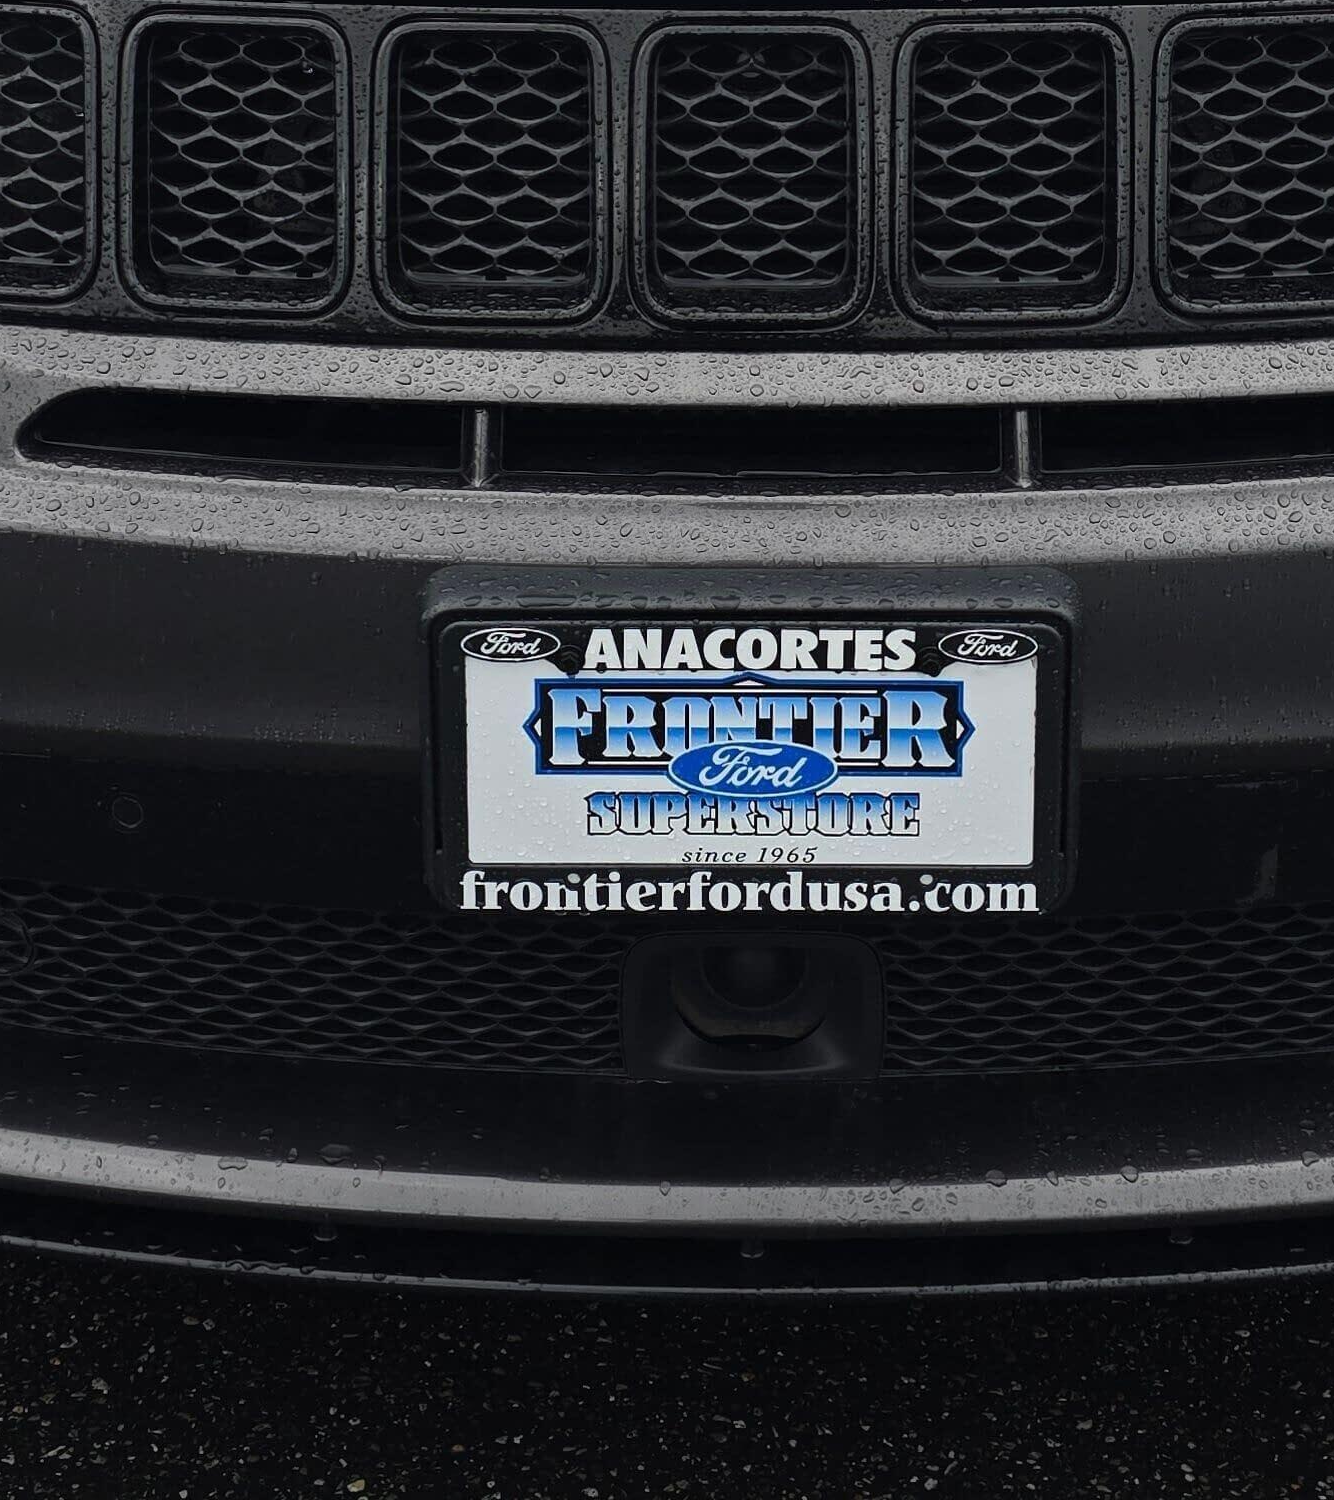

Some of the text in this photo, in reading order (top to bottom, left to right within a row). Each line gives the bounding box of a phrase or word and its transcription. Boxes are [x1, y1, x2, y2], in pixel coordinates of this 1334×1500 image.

[480, 631, 542, 655] Ford
[584, 628, 917, 670] ANACORTES
[957, 633, 1019, 657] Ford
[548, 688, 956, 769] FRONTIER
[698, 745, 809, 788] Ford
[585, 791, 921, 838] SUPERSTORE
[681, 846, 819, 863] since 1965
[459, 871, 1040, 914] frontierfordusa.com
